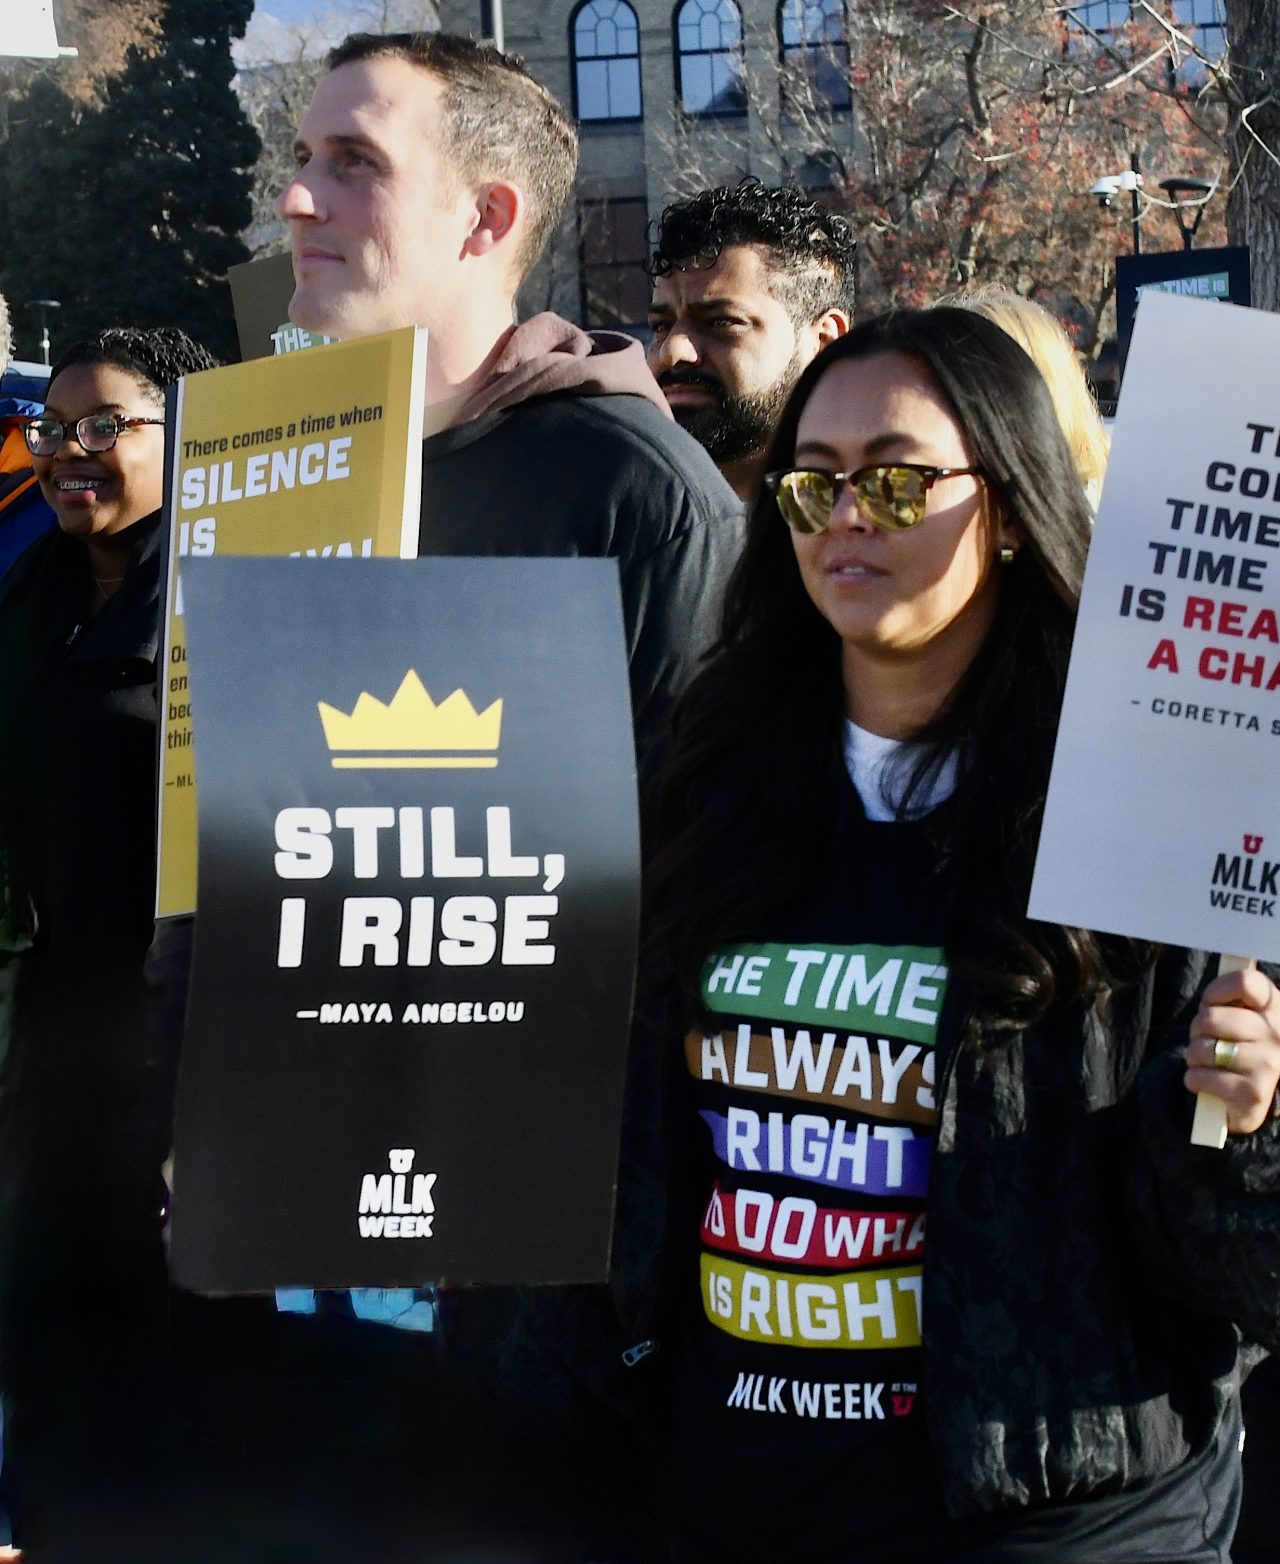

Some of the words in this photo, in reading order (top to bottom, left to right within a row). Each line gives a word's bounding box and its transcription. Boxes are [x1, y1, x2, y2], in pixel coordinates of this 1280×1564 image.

[1163, 278, 1209, 296] TIME
[270, 327, 312, 356] THE
[184, 437, 228, 459] There
[232, 426, 283, 449] comes
[287, 422, 296, 438] a
[300, 414, 335, 436] time
[339, 405, 383, 427] when
[181, 436, 352, 510] SILENCE
[179, 517, 216, 557] IS
[1149, 542, 1268, 592] TIME
[1119, 585, 1167, 623] IS
[1147, 639, 1180, 674] A
[1151, 698, 1260, 731] CORETTA
[275, 806, 565, 892] STILL,
[1210, 889, 1276, 917] WEEK
[277, 898, 306, 968] I
[339, 895, 559, 967] RISE
[784, 949, 948, 1025] TIME
[402, 1002, 525, 1023] ANGELOU
[727, 1106, 915, 1187] RIGHT
[358, 1173, 438, 1214] MLK
[358, 1215, 434, 1238] WEEK
[735, 1188, 817, 1259] DO
[709, 1272, 732, 1319] IS
[727, 1372, 788, 1414] MLK
[792, 1379, 886, 1420] WEEK
